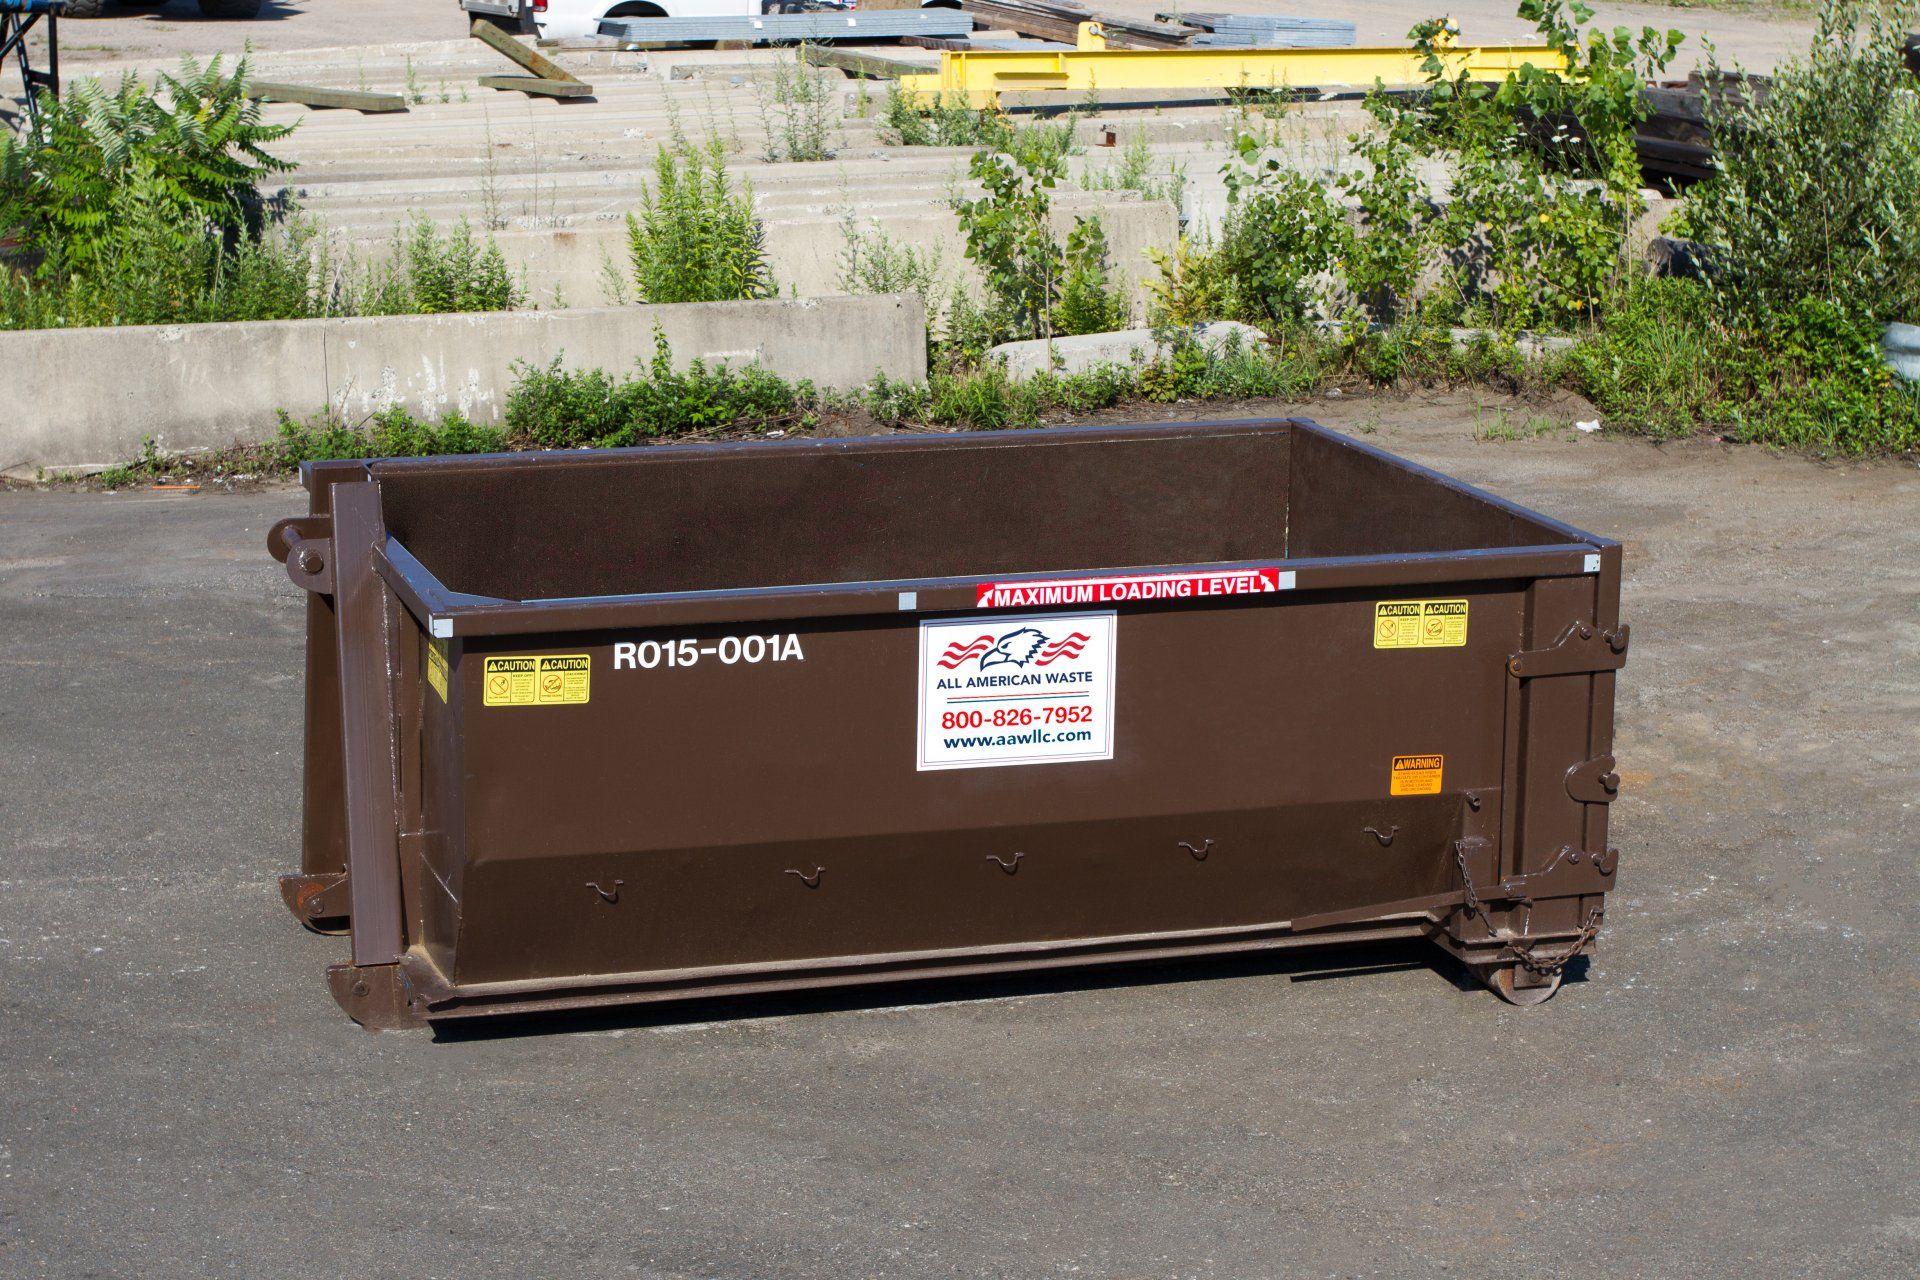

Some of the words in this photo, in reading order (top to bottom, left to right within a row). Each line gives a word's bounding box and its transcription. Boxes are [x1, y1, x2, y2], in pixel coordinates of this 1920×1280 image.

[994, 585, 1093, 607] MAXIMUM
[1100, 579, 1191, 601] LOADING
[1198, 576, 1261, 596] LEVEL
[1387, 605, 1420, 615] CAUTION
[1433, 604, 1466, 614] CAUTION
[497, 661, 535, 671] CAUTION
[550, 659, 588, 670] CAUTION
[936, 678, 962, 690] ALL
[966, 674, 1041, 688] AMERICAN
[1046, 671, 1093, 684] WASTE
[941, 706, 1092, 730] 800-826-7952
[943, 729, 1092, 749] www.aawllc.com
[1403, 758, 1440, 769] WARNING
